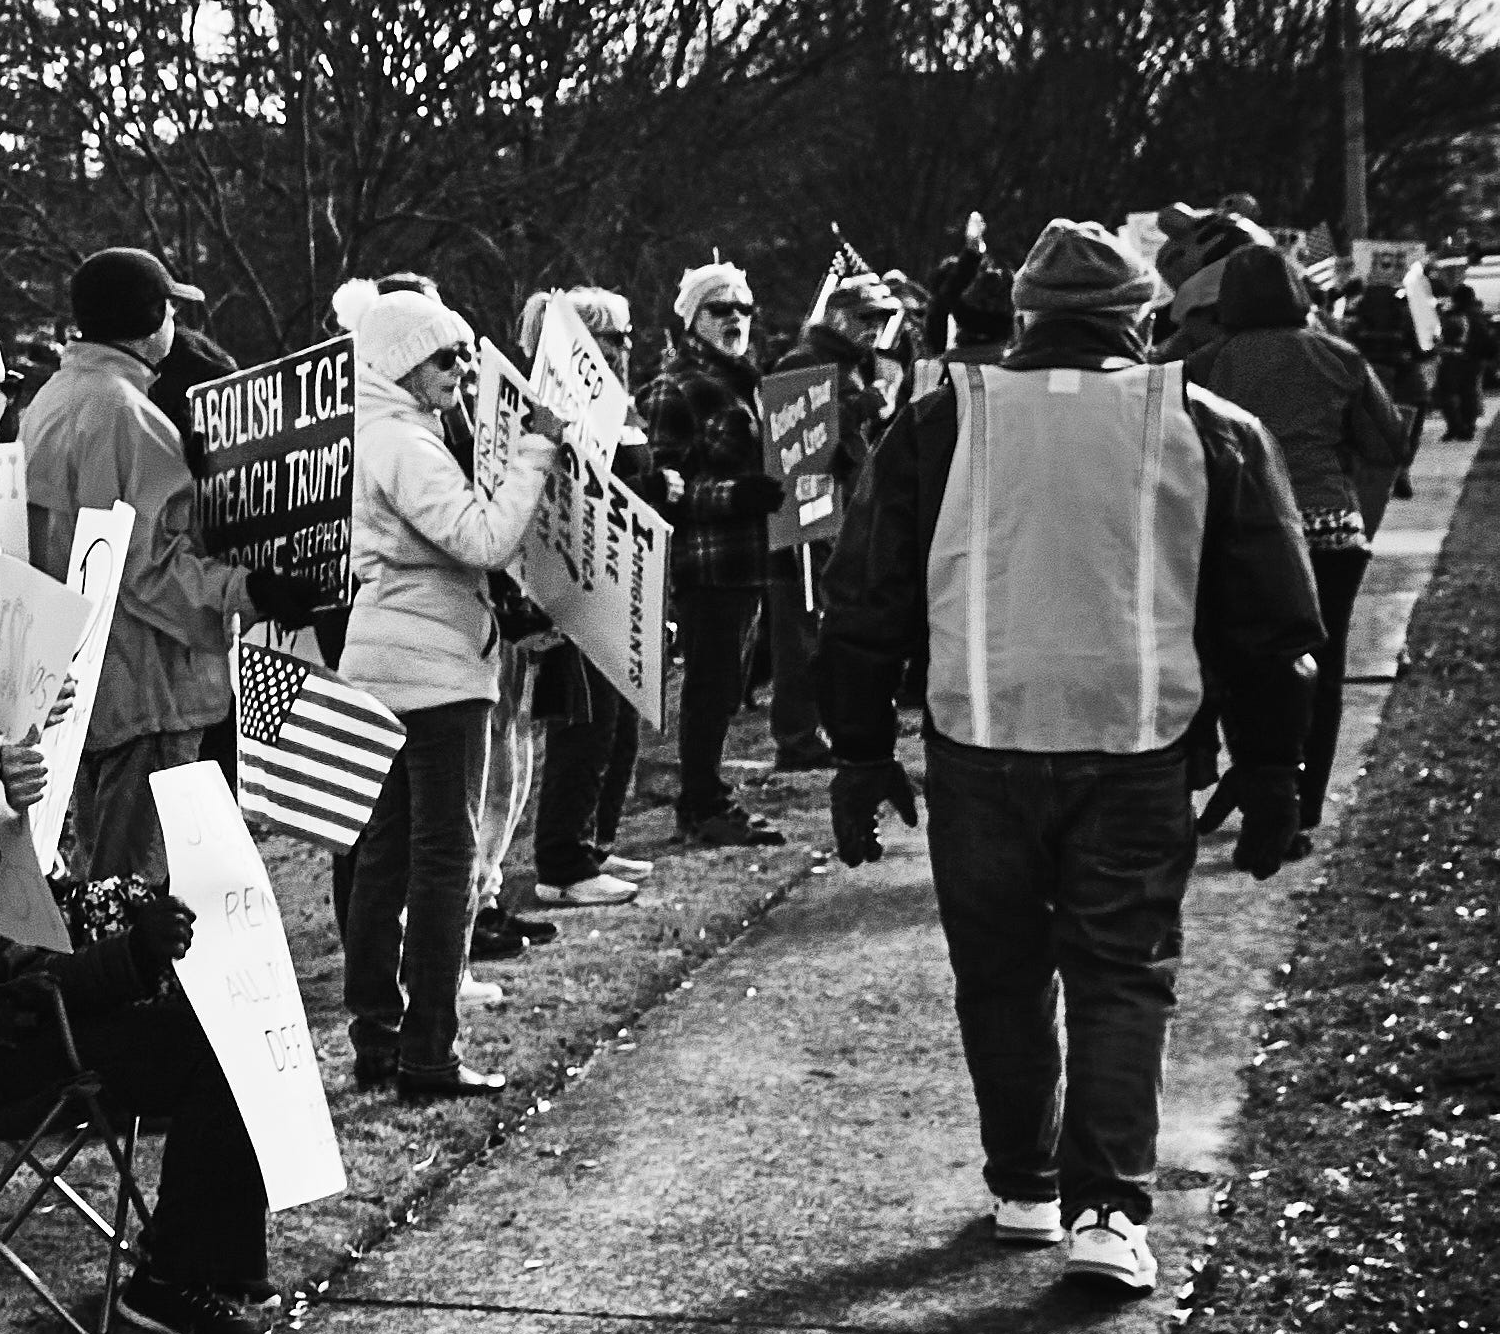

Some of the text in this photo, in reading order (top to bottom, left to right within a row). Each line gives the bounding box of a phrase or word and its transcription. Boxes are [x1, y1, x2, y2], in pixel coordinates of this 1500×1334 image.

[191, 351, 354, 453] ABOLISH I.C.E.
[285, 436, 352, 512] TRUMP
[605, 480, 629, 585] MAKE
[629, 511, 654, 690] IMMIGRANTS
